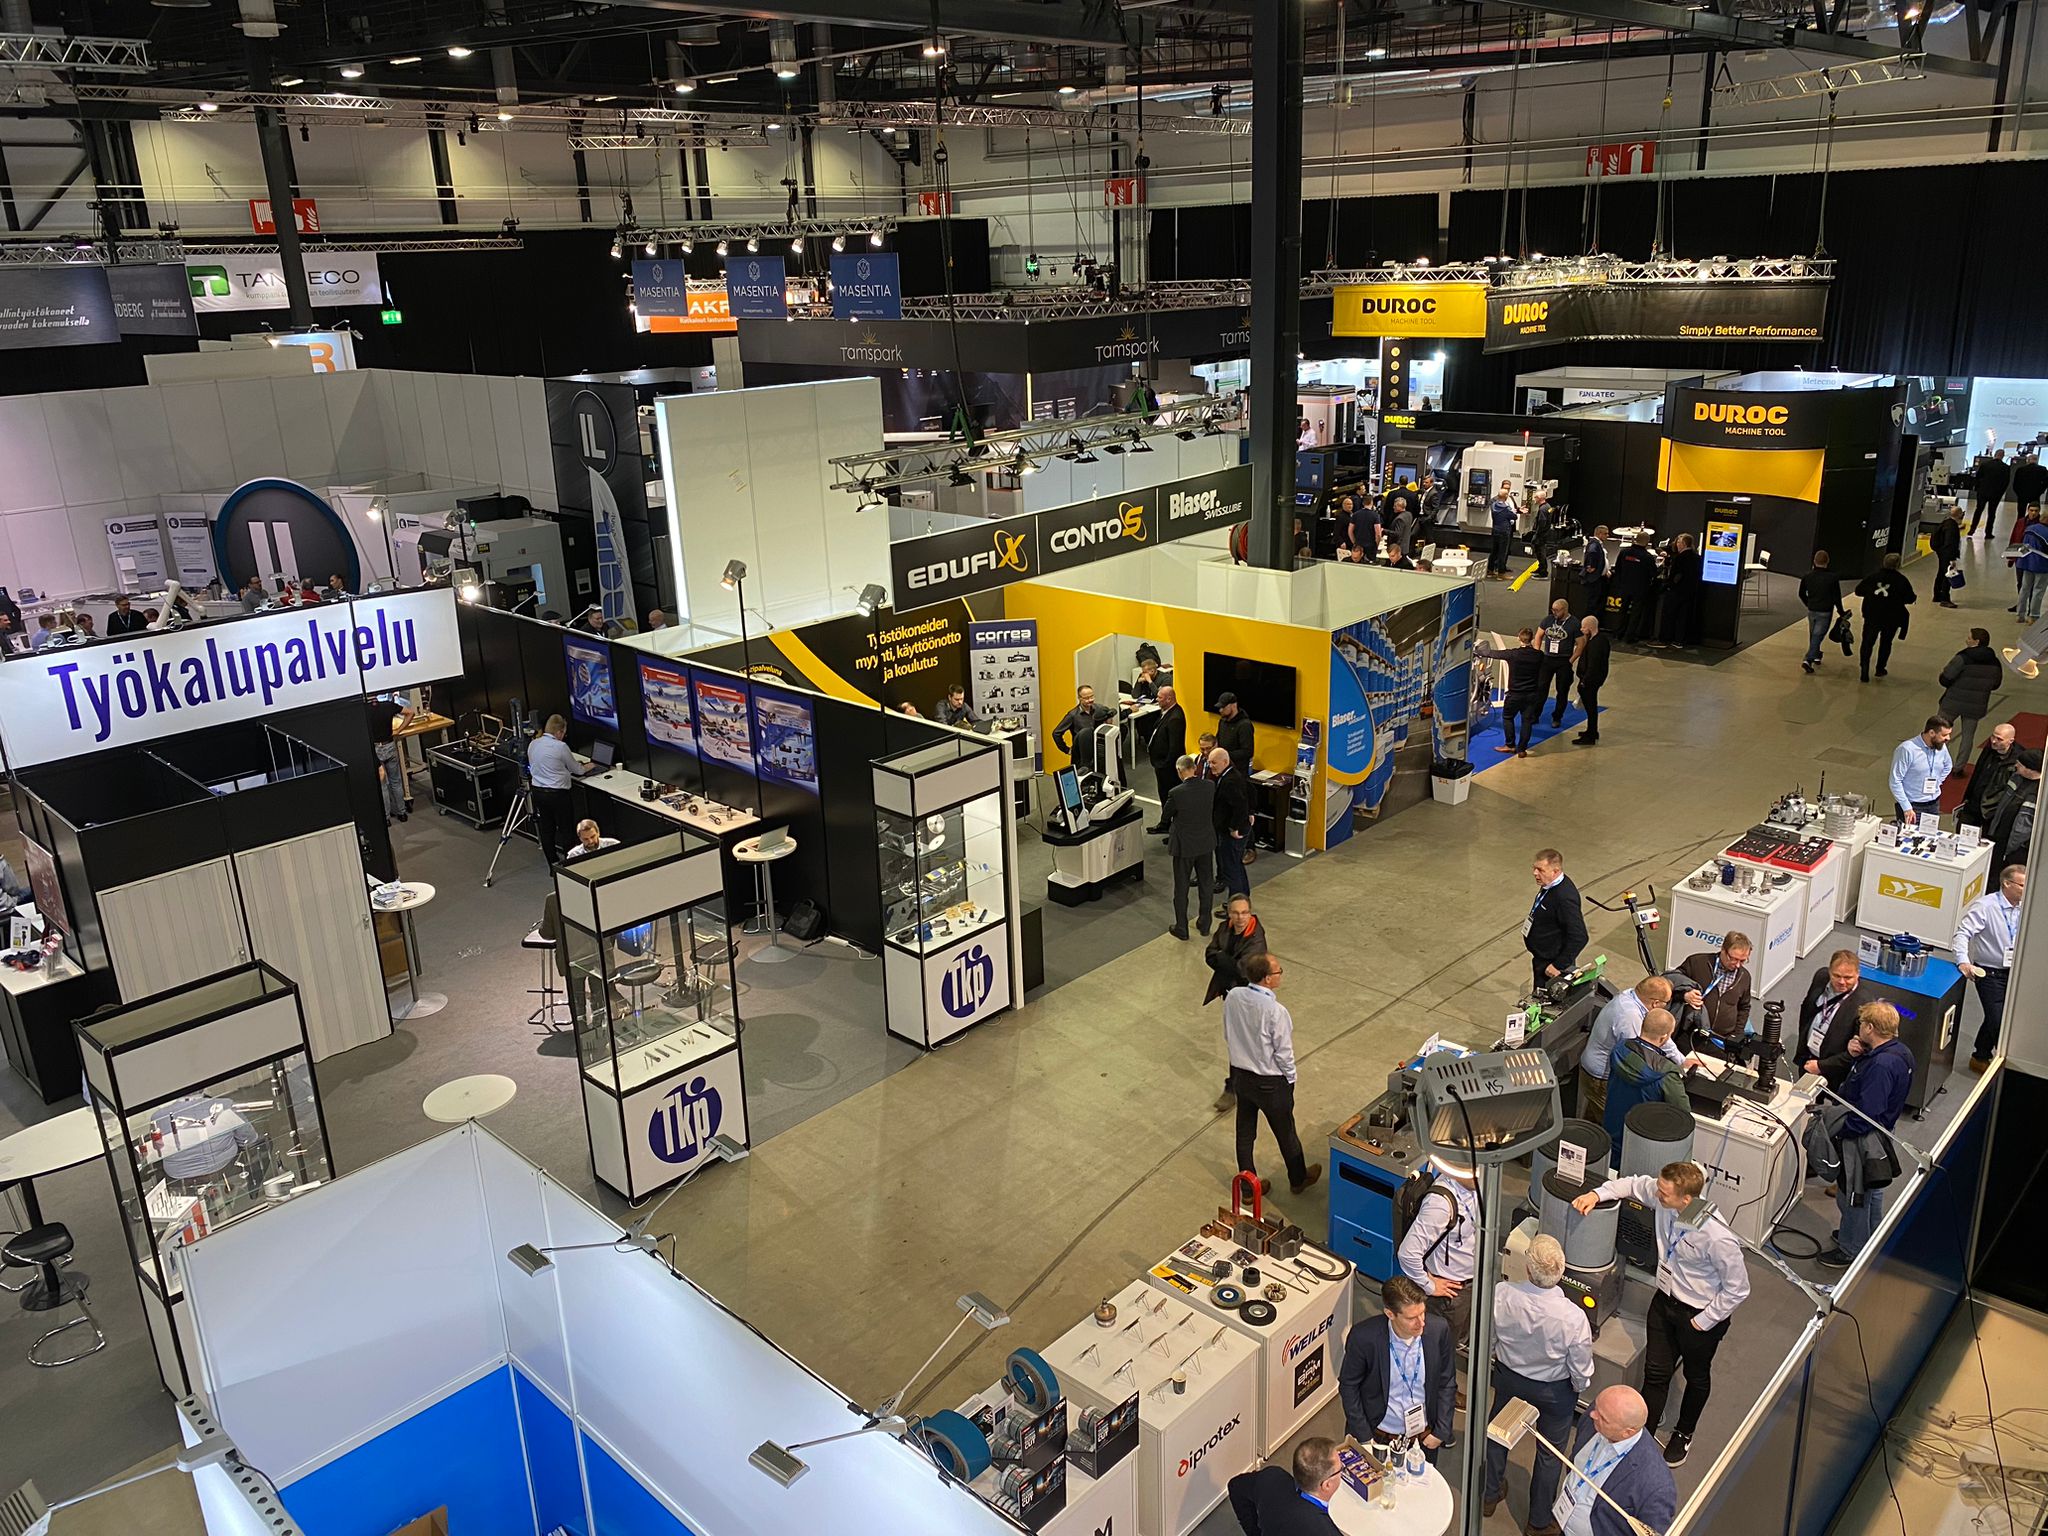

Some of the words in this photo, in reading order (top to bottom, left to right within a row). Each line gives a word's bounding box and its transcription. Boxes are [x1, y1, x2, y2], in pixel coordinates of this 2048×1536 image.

[640, 286, 680, 298] MASENTIA
[733, 285, 779, 297] MASENTIA
[839, 284, 892, 297] MASENTIA
[1362, 298, 1437, 315] DUROC
[1503, 301, 1549, 326] DUROC
[32, 318, 90, 328] kokemuksella
[1390, 317, 1418, 325] MACHINE
[1420, 317, 1437, 325] TOOL
[1219, 330, 1250, 348] Tams
[1679, 325, 1713, 337] Simply
[1714, 325, 1747, 336] Better
[1749, 325, 1818, 337] Performance
[840, 344, 903, 363] Tamspark
[1095, 336, 1160, 362] Tamspark
[1802, 377, 1836, 386] Metecno
[1996, 396, 2036, 406] DIGILOG
[1383, 415, 1416, 425] DUROC
[1694, 402, 1788, 425] DUROC
[1725, 427, 1762, 436] MACHINE
[1764, 428, 1787, 436] TOOL
[1170, 489, 1221, 520] Blaser.
[1204, 502, 1243, 521] SWISSLUBE
[1050, 502, 1147, 553] CONTOS
[907, 530, 1028, 590] EDUFIX
[975, 629, 1032, 643] correa
[896, 632, 962, 660] käyttöönotto
[47, 608, 418, 743] Työkalupalvelu
[882, 666, 894, 684] ja
[894, 655, 939, 678] koulutus
[949, 956, 985, 1011] Tkp
[655, 1090, 711, 1156] Tkp
[1289, 1313, 1335, 1361] WEILER
[1021, 1495, 1034, 1508] CUT
